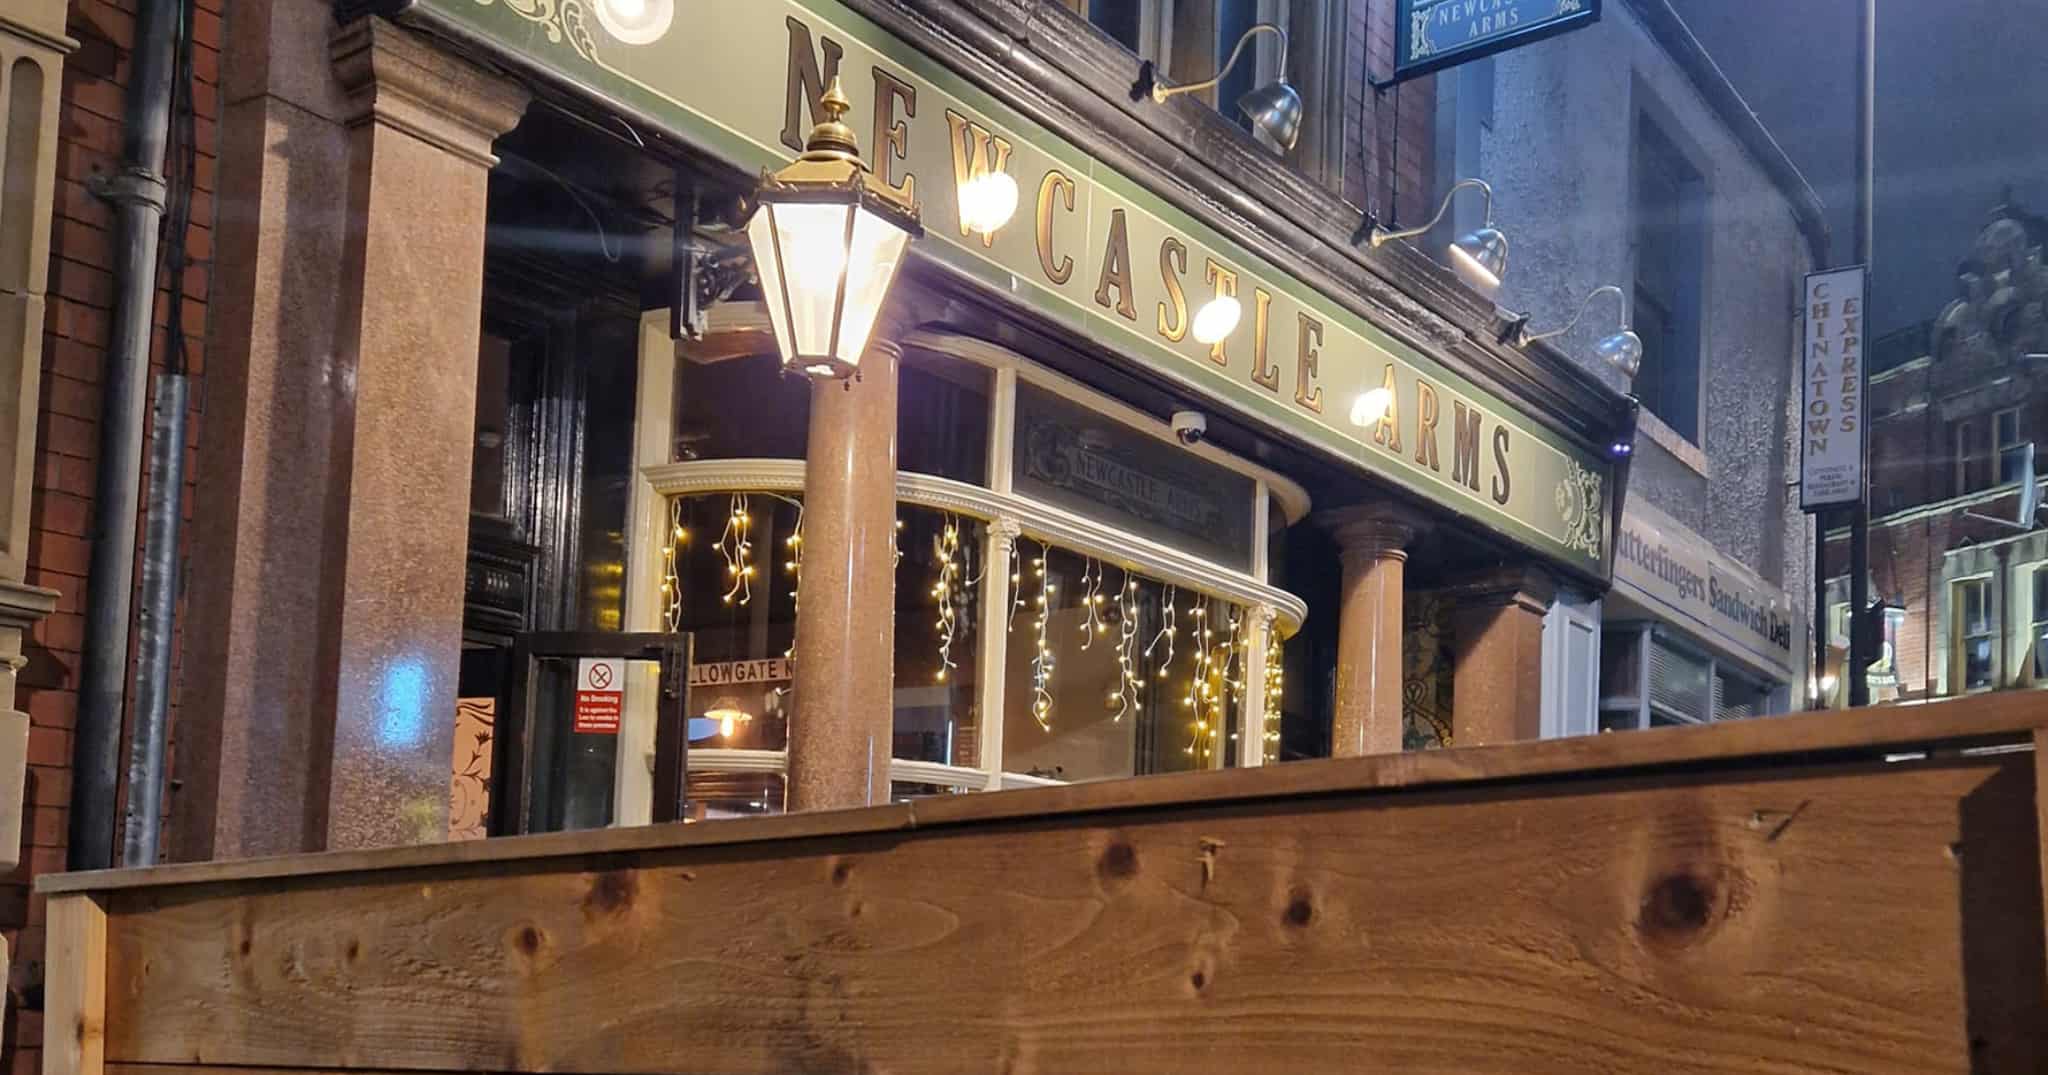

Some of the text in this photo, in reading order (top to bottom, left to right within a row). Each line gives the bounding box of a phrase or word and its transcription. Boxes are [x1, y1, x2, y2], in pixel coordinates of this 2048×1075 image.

[1468, 7, 1519, 39] ARMS
[780, 15, 1511, 505] NEWCASTLE ARMS
[1808, 282, 1831, 457] CHINATOWN
[1839, 298, 1860, 433] EXPRESS
[1709, 575, 1768, 639] Sandwich
[1769, 611, 1791, 650] Deli
[690, 661, 777, 685] LOWGATE
